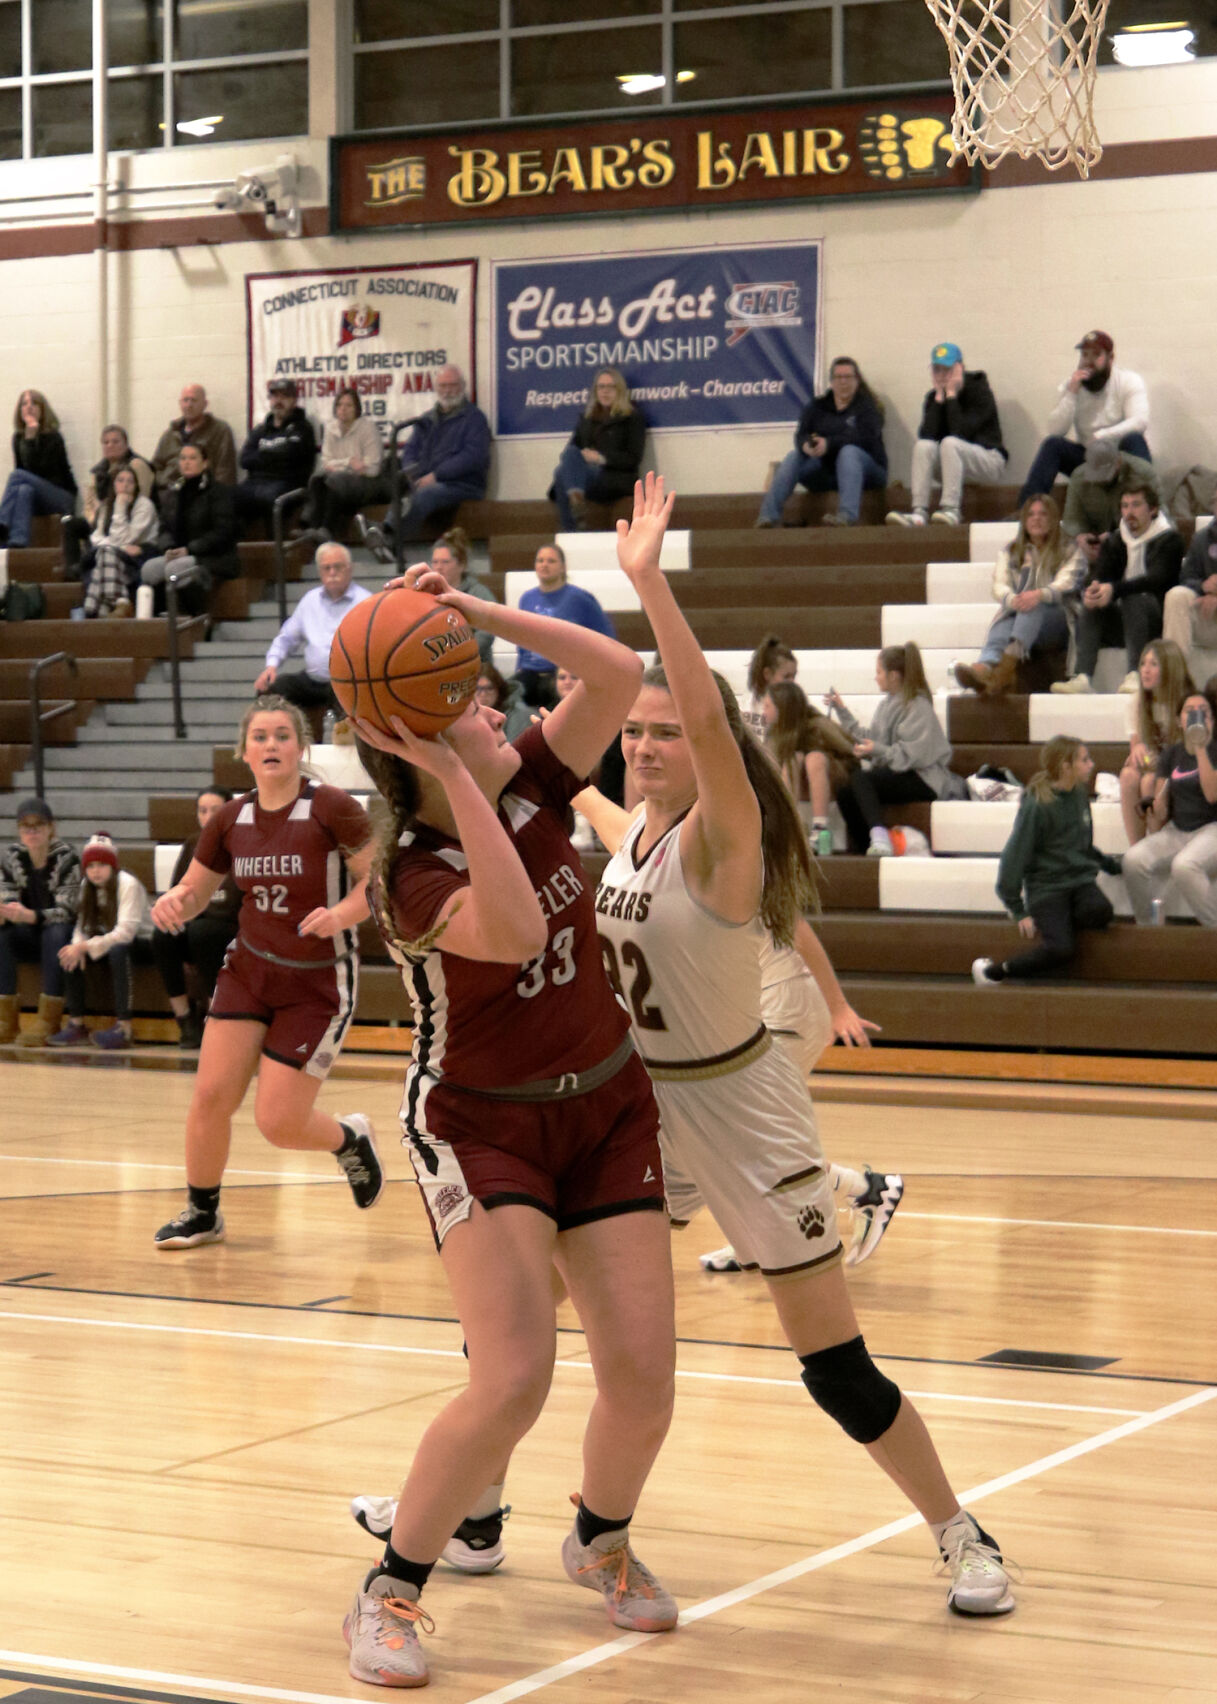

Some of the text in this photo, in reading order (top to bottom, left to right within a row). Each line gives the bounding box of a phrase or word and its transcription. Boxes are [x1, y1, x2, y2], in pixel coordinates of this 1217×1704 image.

[367, 128, 850, 207] THE BEAR'S LAIR
[263, 278, 458, 315] CONNECTICUT ASSOCIATION
[507, 278, 716, 340] Class Act
[736, 286, 800, 315] CIAC
[275, 349, 447, 374] ATHLETIC DIRECTORS
[506, 335, 719, 370] SPORTSMANSHIP
[525, 388, 589, 407] Respect
[630, 381, 689, 401] mwork
[703, 378, 786, 398] Character
[363, 399, 386, 416] 18
[234, 855, 302, 877] WHEELER
[252, 884, 289, 913] 32
[516, 926, 576, 998] 33
